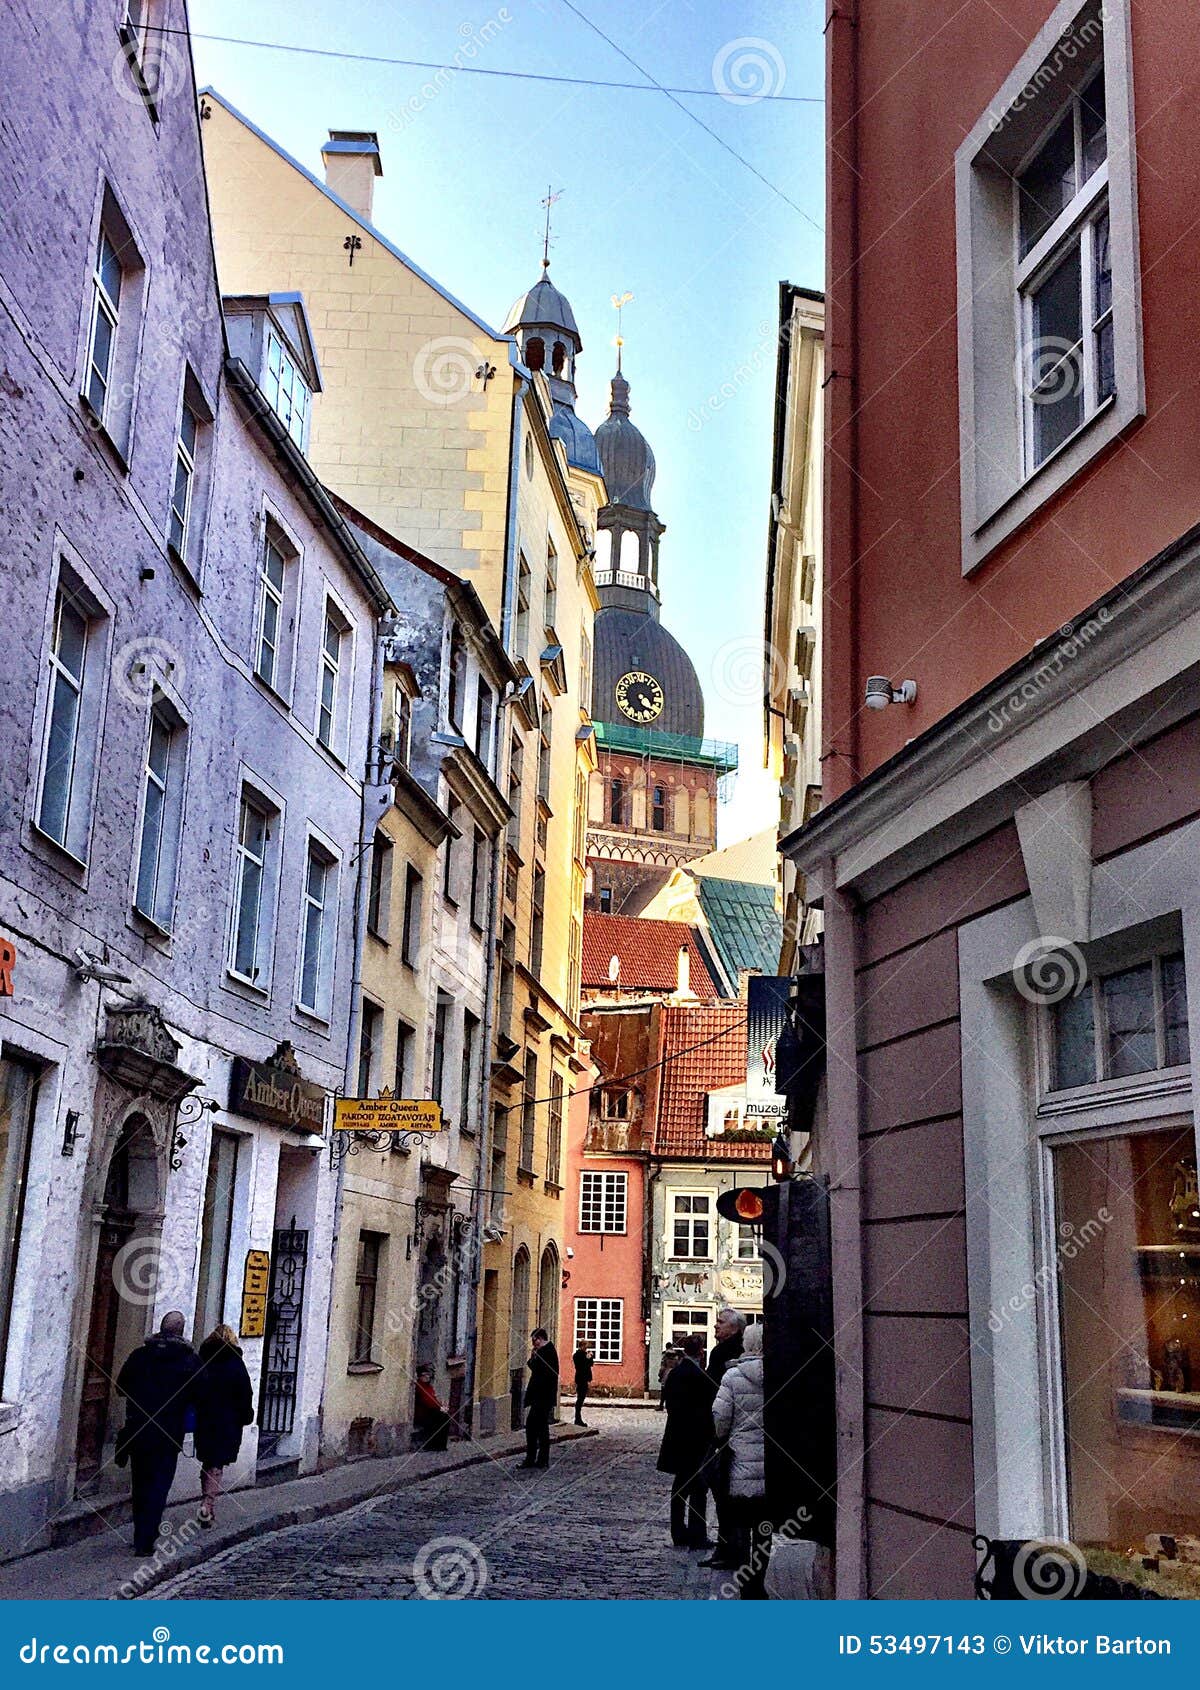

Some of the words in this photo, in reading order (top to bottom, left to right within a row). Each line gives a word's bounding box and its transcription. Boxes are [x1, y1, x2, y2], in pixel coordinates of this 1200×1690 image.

[243, 1067, 290, 1111] Amber
[358, 1102, 387, 1111] Amber
[390, 1102, 419, 1113] Queen
